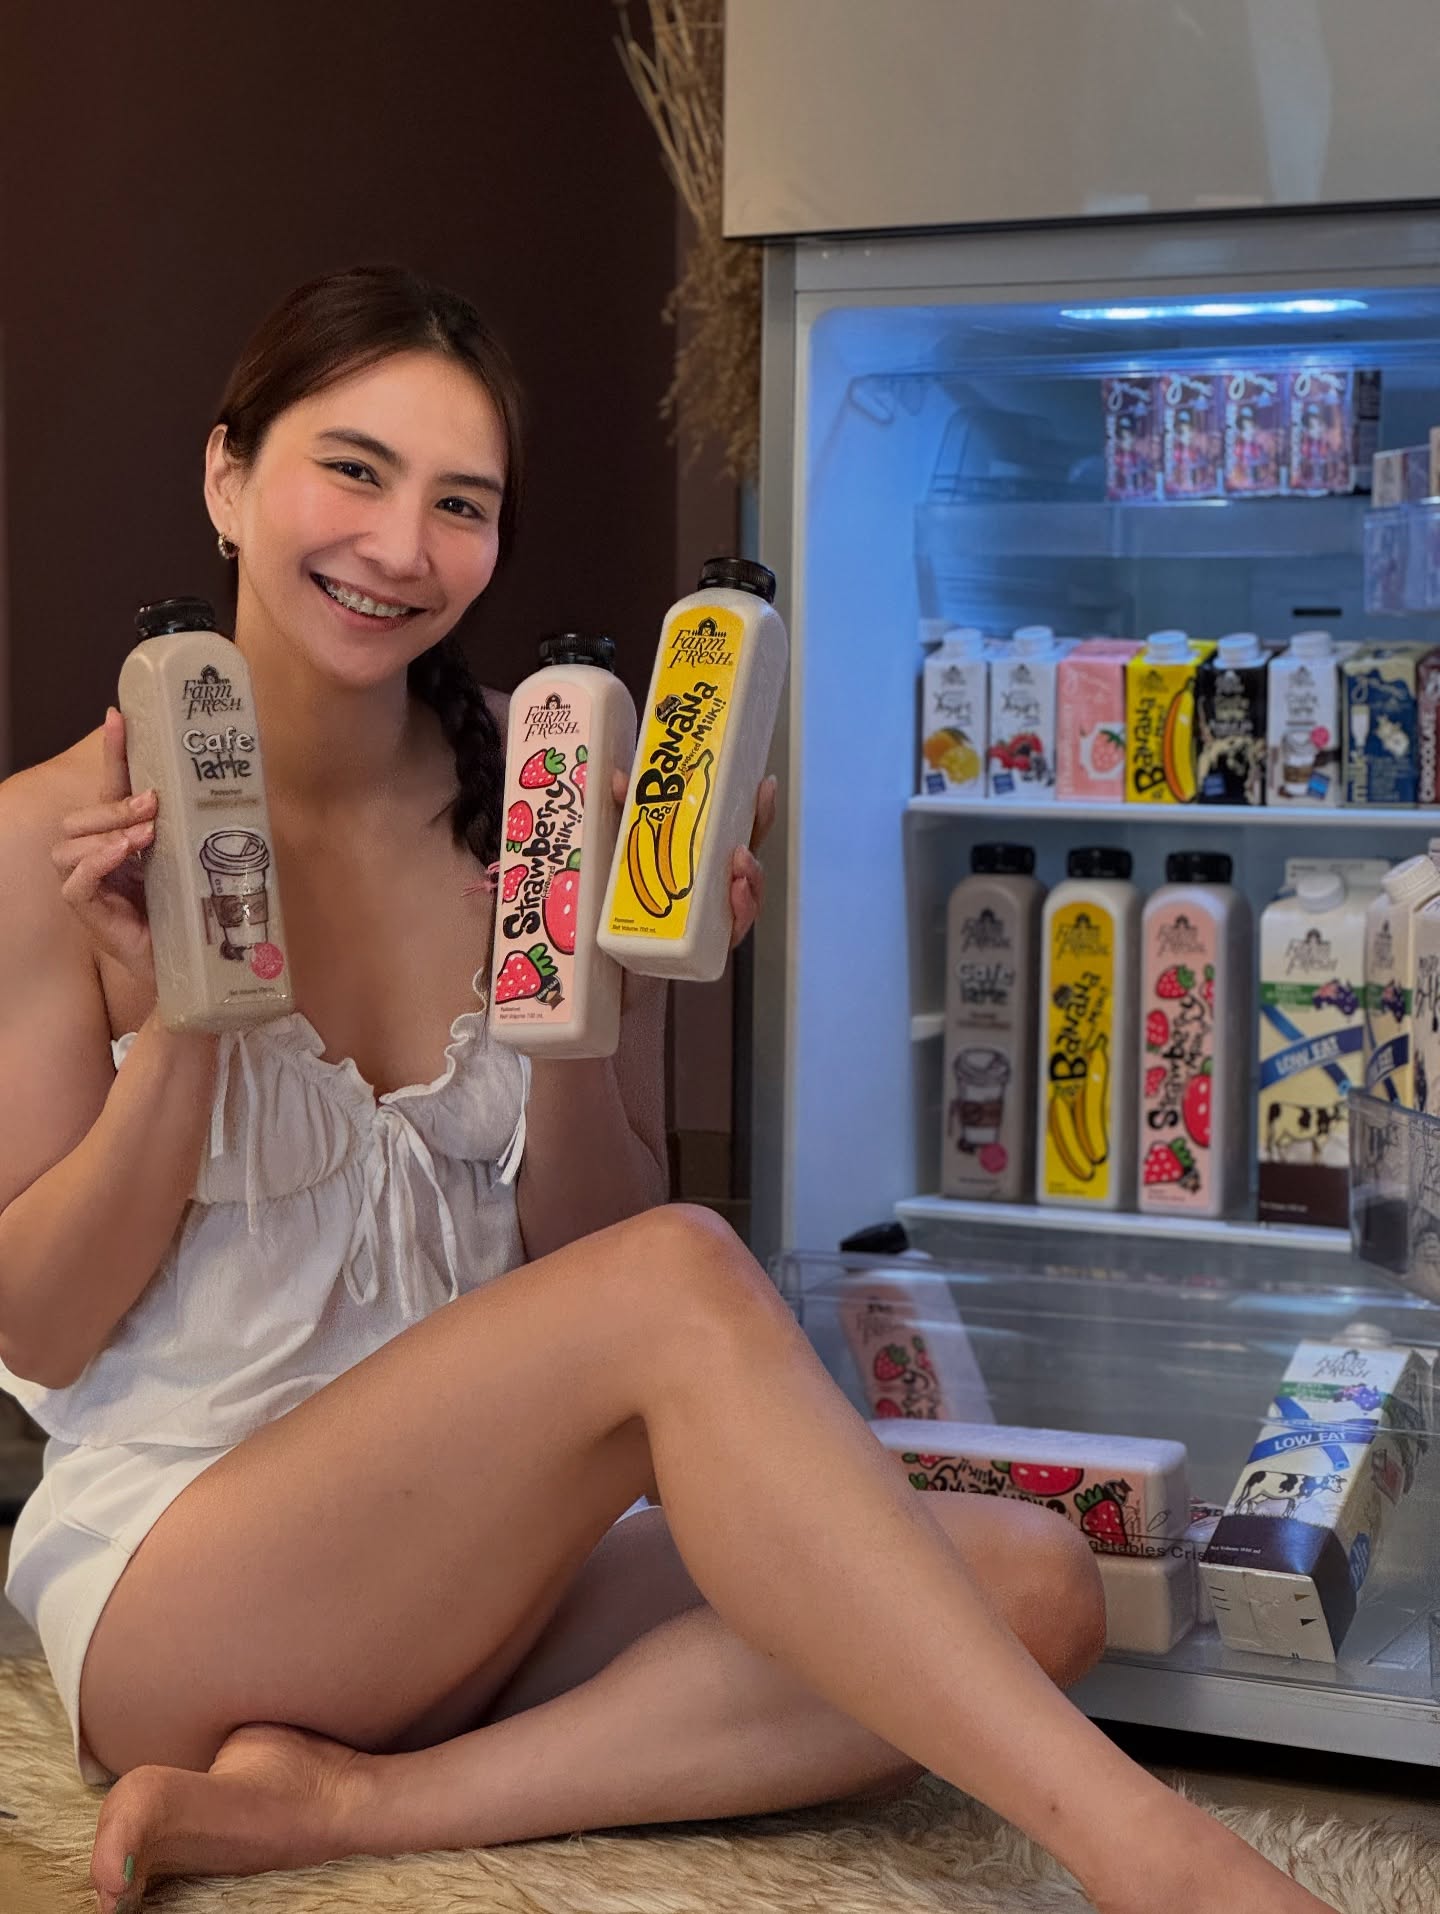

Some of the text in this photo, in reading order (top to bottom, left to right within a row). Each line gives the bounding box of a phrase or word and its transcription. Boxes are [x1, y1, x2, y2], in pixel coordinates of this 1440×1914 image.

[182, 726, 255, 754] Cafe
[191, 752, 252, 781] latte
[503, 780, 575, 940] Strawberry
[1274, 1433, 1312, 1451] LOW
[1089, 1540, 1166, 1558] getables
